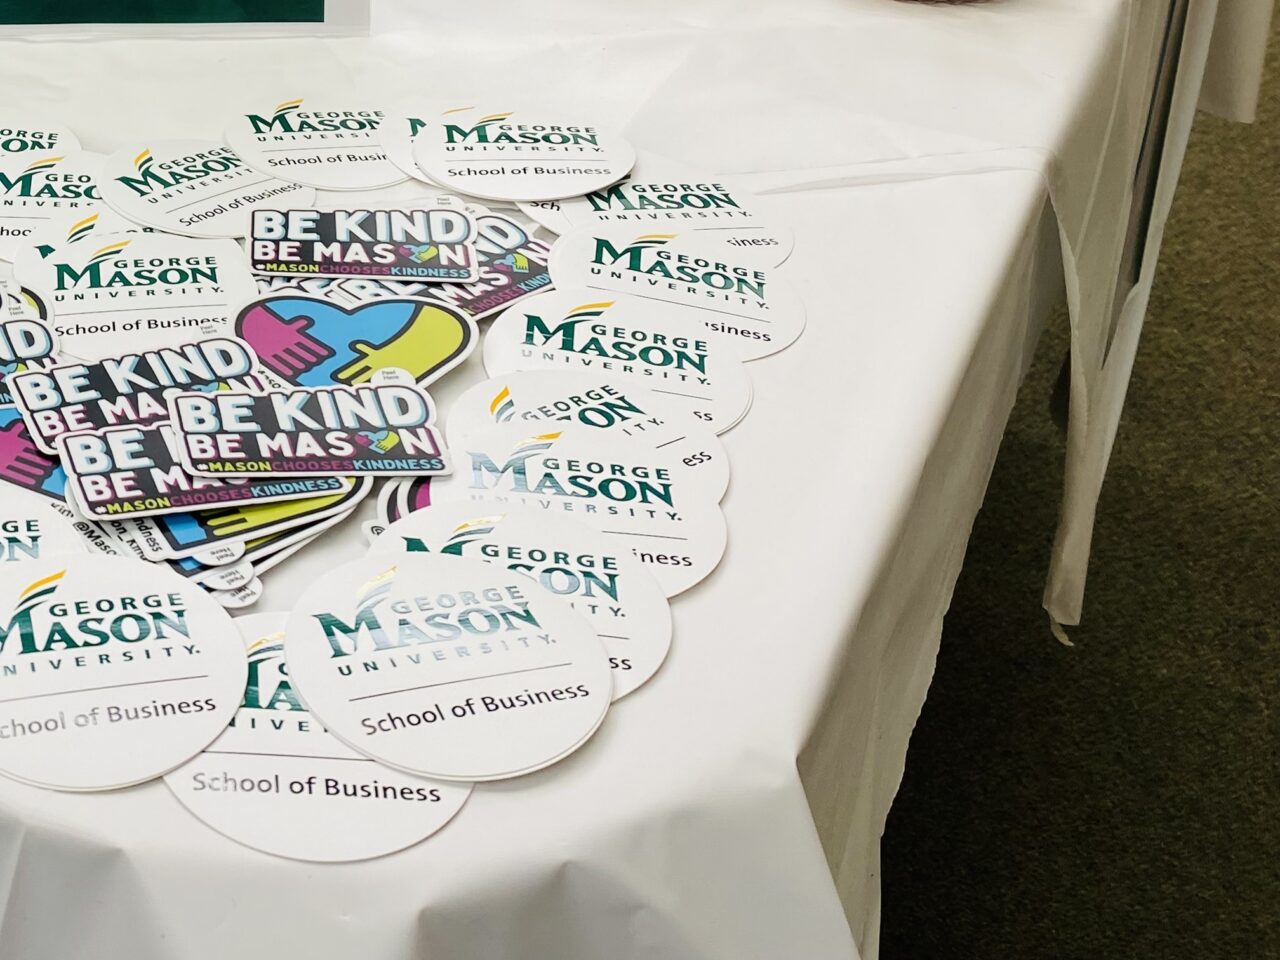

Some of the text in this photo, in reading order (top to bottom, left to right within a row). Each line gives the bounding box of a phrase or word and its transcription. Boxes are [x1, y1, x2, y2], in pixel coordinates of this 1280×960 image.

[442, 123, 600, 146] MASON
[499, 125, 595, 134] GEORGE
[268, 155, 342, 167] School of
[448, 164, 612, 178] School of Business
[632, 183, 726, 193] GEORGE
[252, 210, 472, 243] BE KIND
[114, 256, 216, 269] GEORGE
[254, 241, 303, 262] BE
[656, 250, 766, 281] GEORGE
[53, 260, 219, 291] MASON
[591, 236, 768, 300] MASON
[55, 319, 142, 336] School of
[591, 324, 708, 353] GEORGE
[520, 313, 709, 376] MASON
[27, 339, 254, 413] BE KIND
[187, 391, 266, 434] BE
[271, 386, 430, 431] KIND
[65, 429, 155, 473] BE
[189, 434, 249, 460] BE
[466, 451, 675, 508] MASON
[543, 458, 671, 482] GEORGE
[86, 470, 144, 502] BE
[481, 544, 618, 571] GEORGE
[49, 593, 184, 617] GEORGE
[391, 585, 524, 615] GEORGE
[311, 601, 543, 659] MASON
[74, 707, 100, 728] of
[107, 696, 217, 723] Business
[361, 683, 591, 737] School of Business
[192, 772, 441, 803] School of Business
